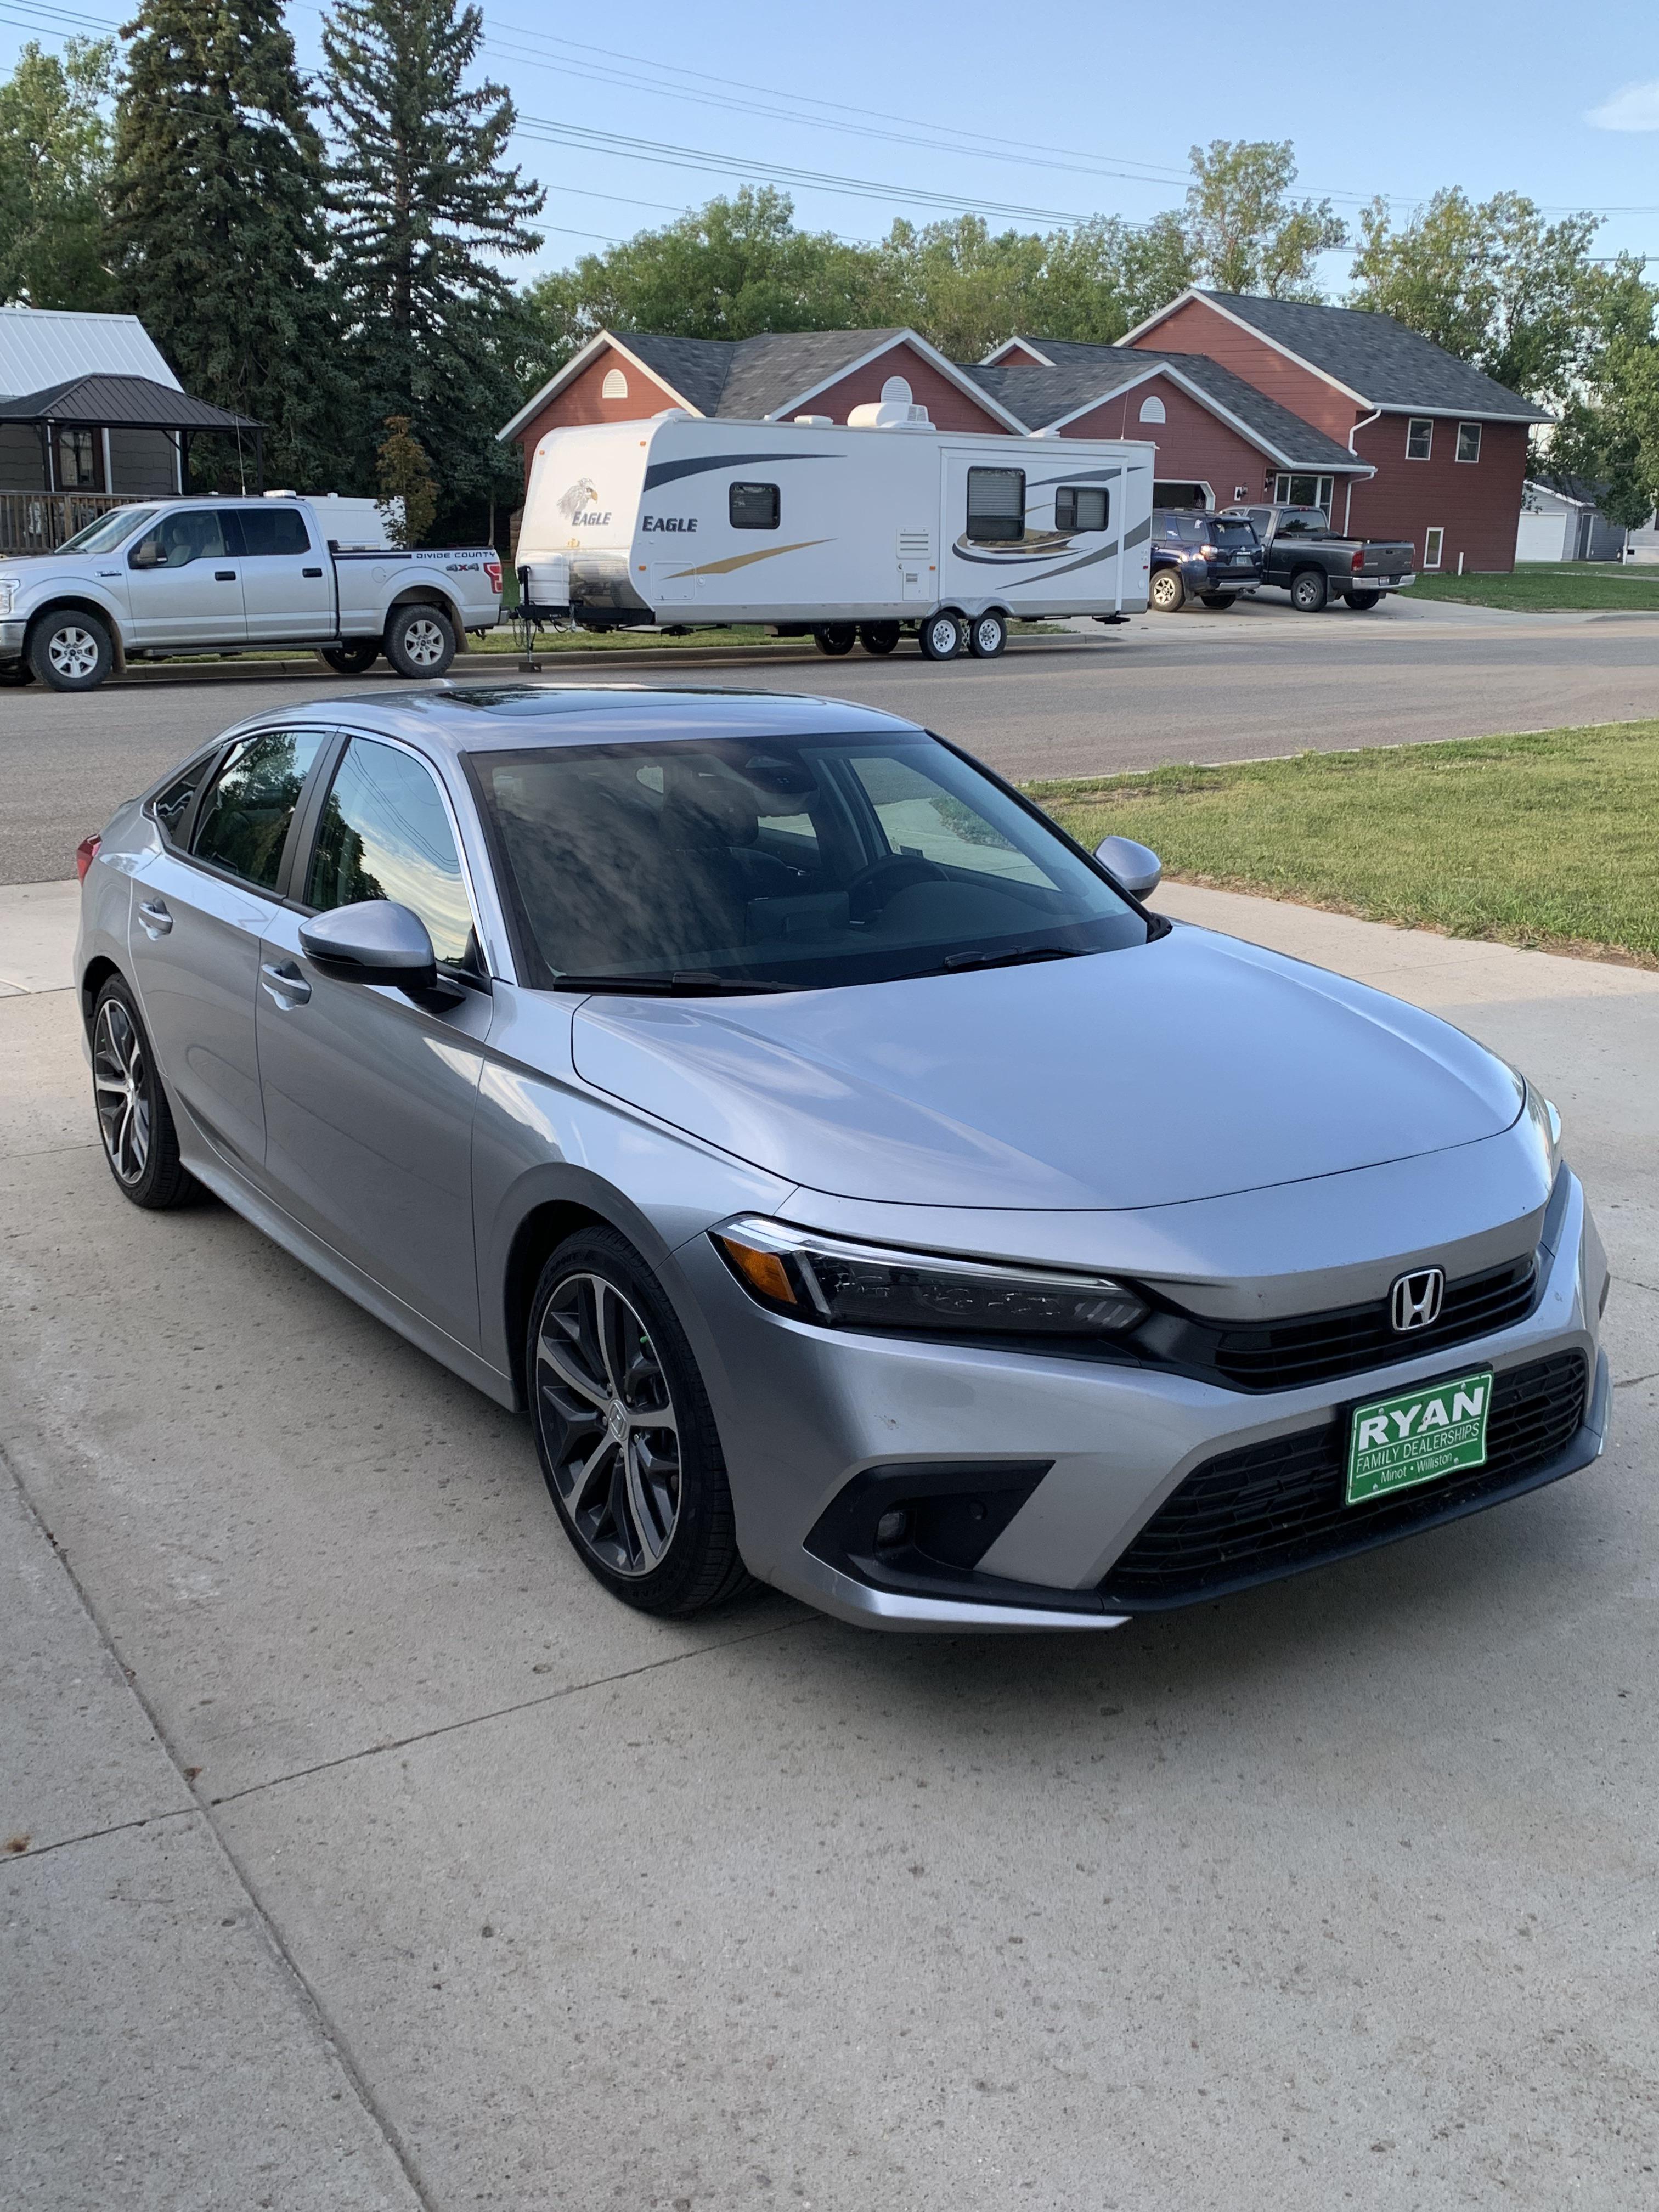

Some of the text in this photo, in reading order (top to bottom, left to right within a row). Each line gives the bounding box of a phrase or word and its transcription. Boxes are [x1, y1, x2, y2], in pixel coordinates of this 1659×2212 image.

[572, 511, 612, 527] EAGLE
[642, 516, 698, 532] EAGLE
[1358, 1386, 1484, 1451] RYAN
[1356, 1422, 1480, 1473] FAMILY DEALERSHIPS
[1380, 1453, 1452, 1483] Minot Williston
